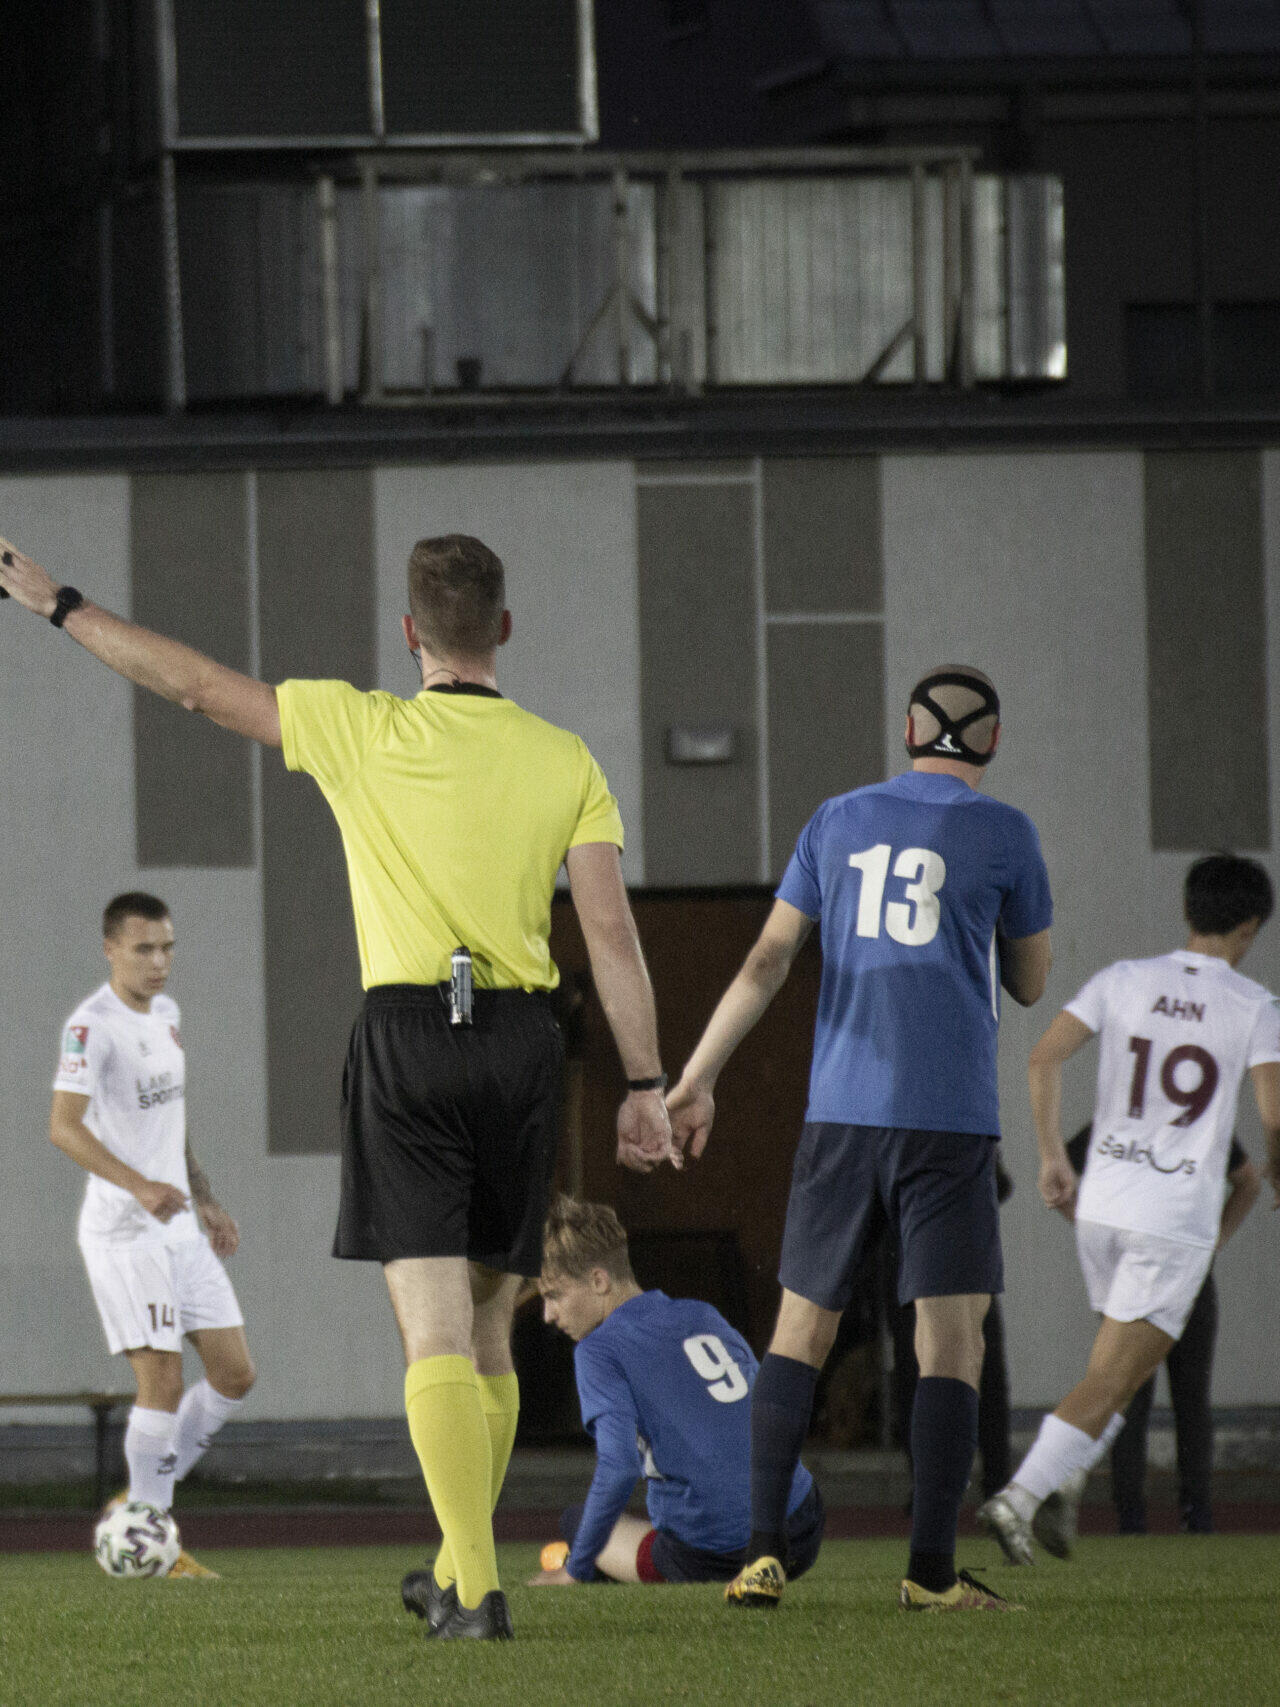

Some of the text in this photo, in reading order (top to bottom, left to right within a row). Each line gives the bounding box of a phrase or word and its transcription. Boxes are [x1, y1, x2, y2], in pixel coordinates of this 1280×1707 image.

[848, 843, 946, 947] 13
[1151, 995, 1206, 1023] AHN
[1128, 1035, 1219, 1129] 19
[147, 1302, 175, 1333] 14
[683, 1334, 748, 1404] 9
